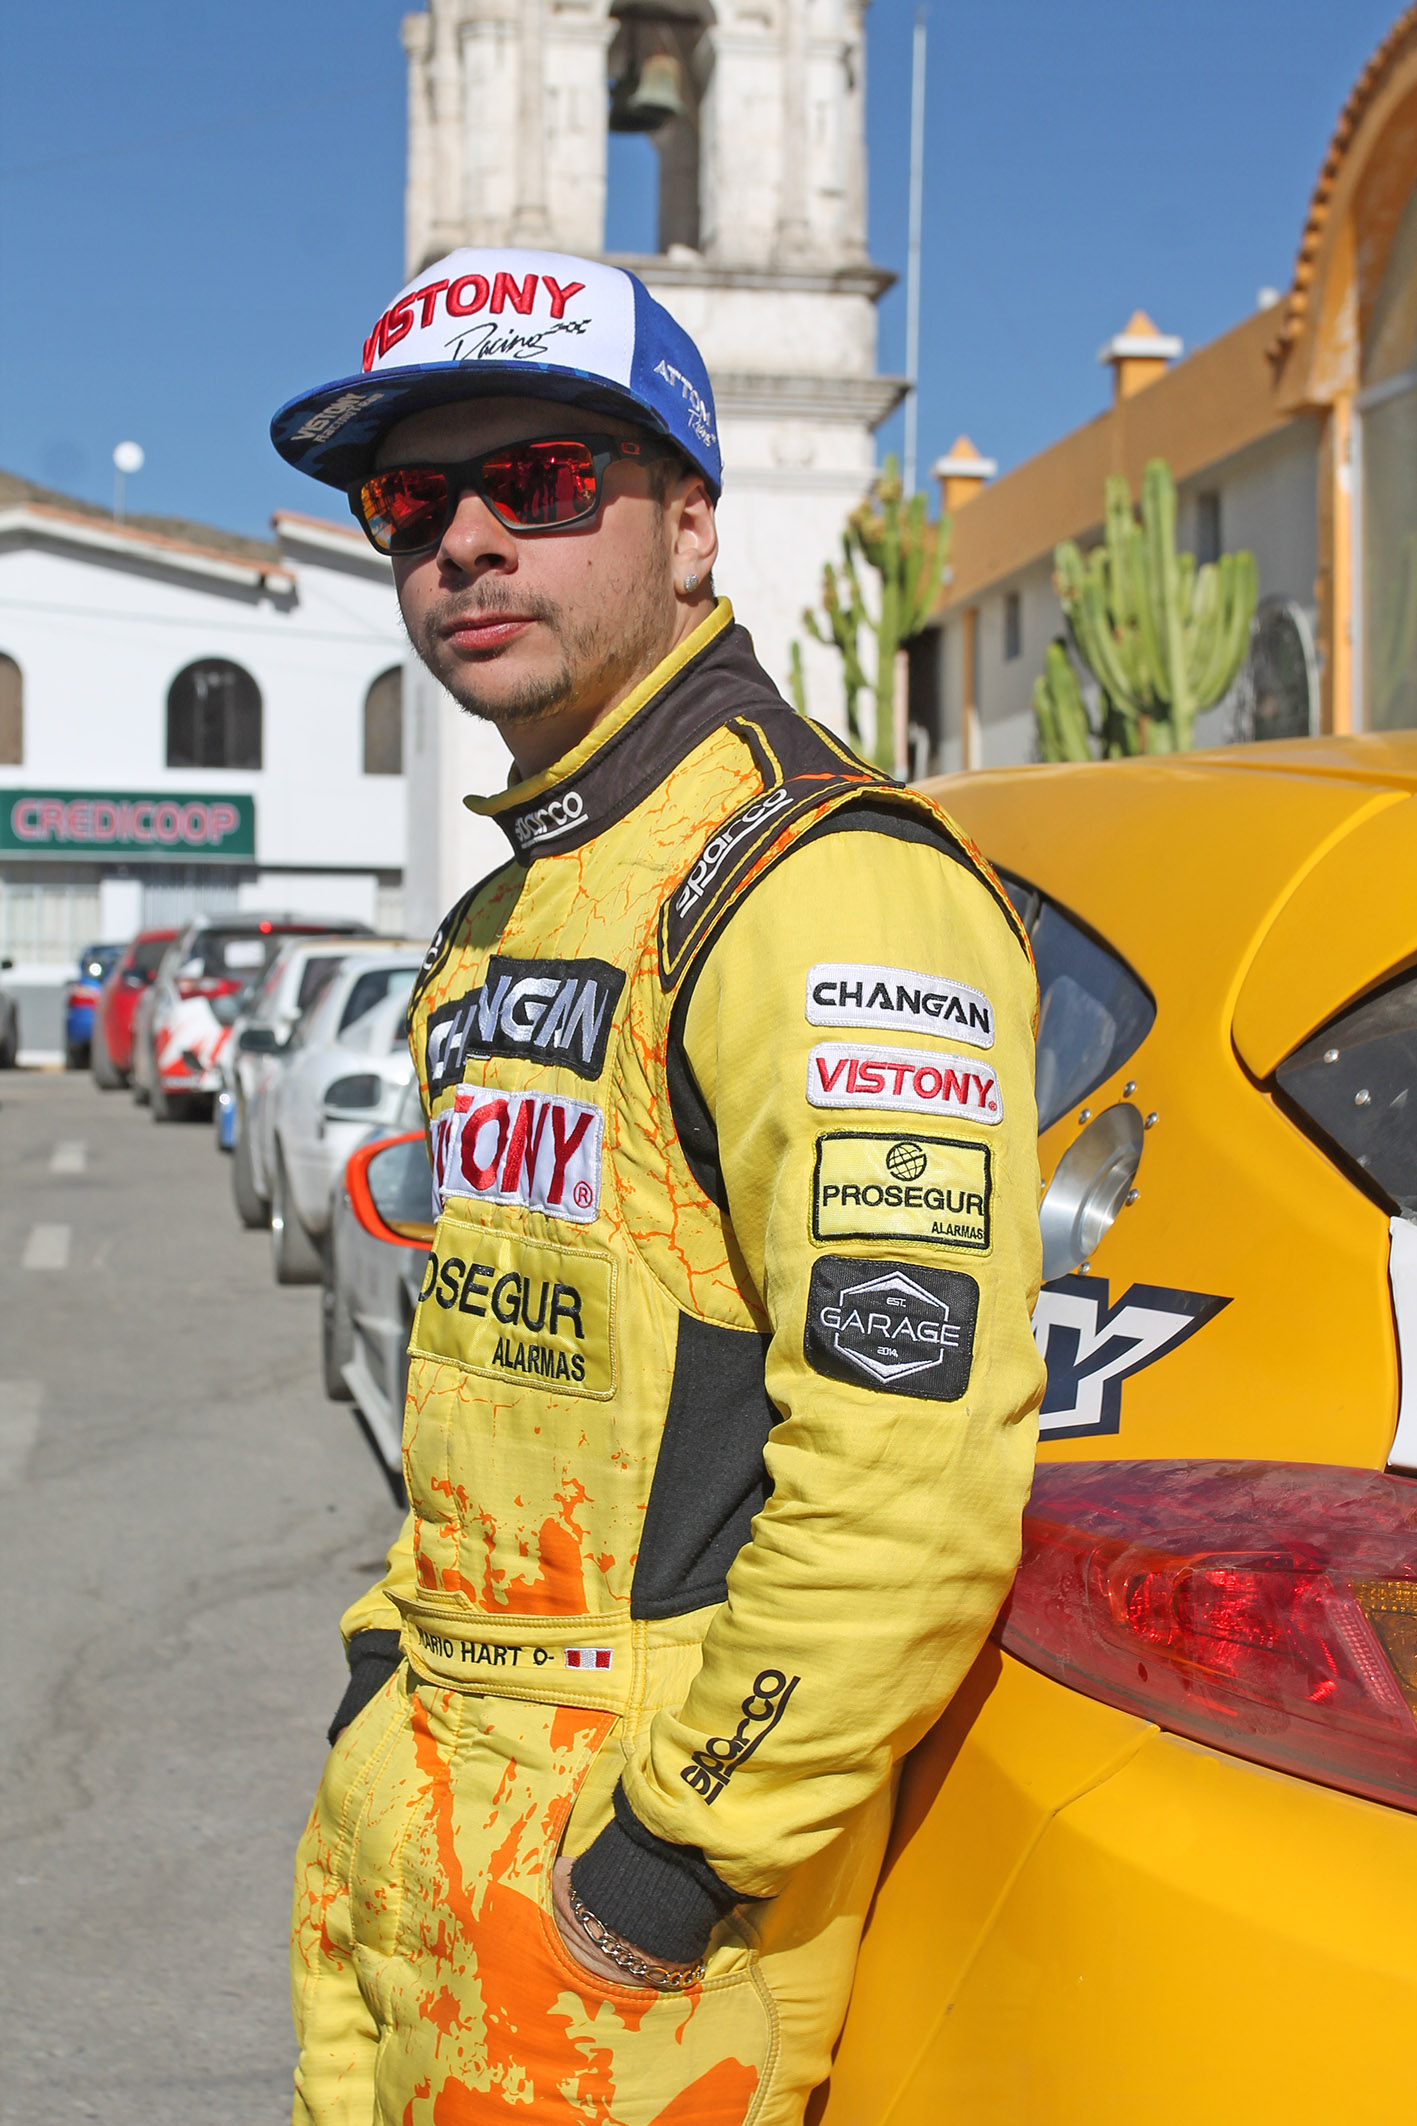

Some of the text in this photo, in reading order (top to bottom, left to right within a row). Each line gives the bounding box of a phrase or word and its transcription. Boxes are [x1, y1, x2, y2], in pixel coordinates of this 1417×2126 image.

[363, 272, 586, 373] VISTONY
[12, 798, 240, 844] CREDICOOP
[515, 791, 585, 844] sparco
[675, 788, 790, 914] sparco
[428, 974, 609, 1080] CHNGAN
[812, 981, 990, 1034] CHANGAN
[822, 1184, 984, 1216] PROSEGUR
[931, 1221, 984, 1240] ALARMAS
[418, 1252, 585, 1339] OSEGUR
[819, 1306, 961, 1347] GARAGE
[492, 1336, 586, 1382] ALARMAS
[461, 1641, 522, 1666] HART
[680, 1669, 790, 1797] sparco
